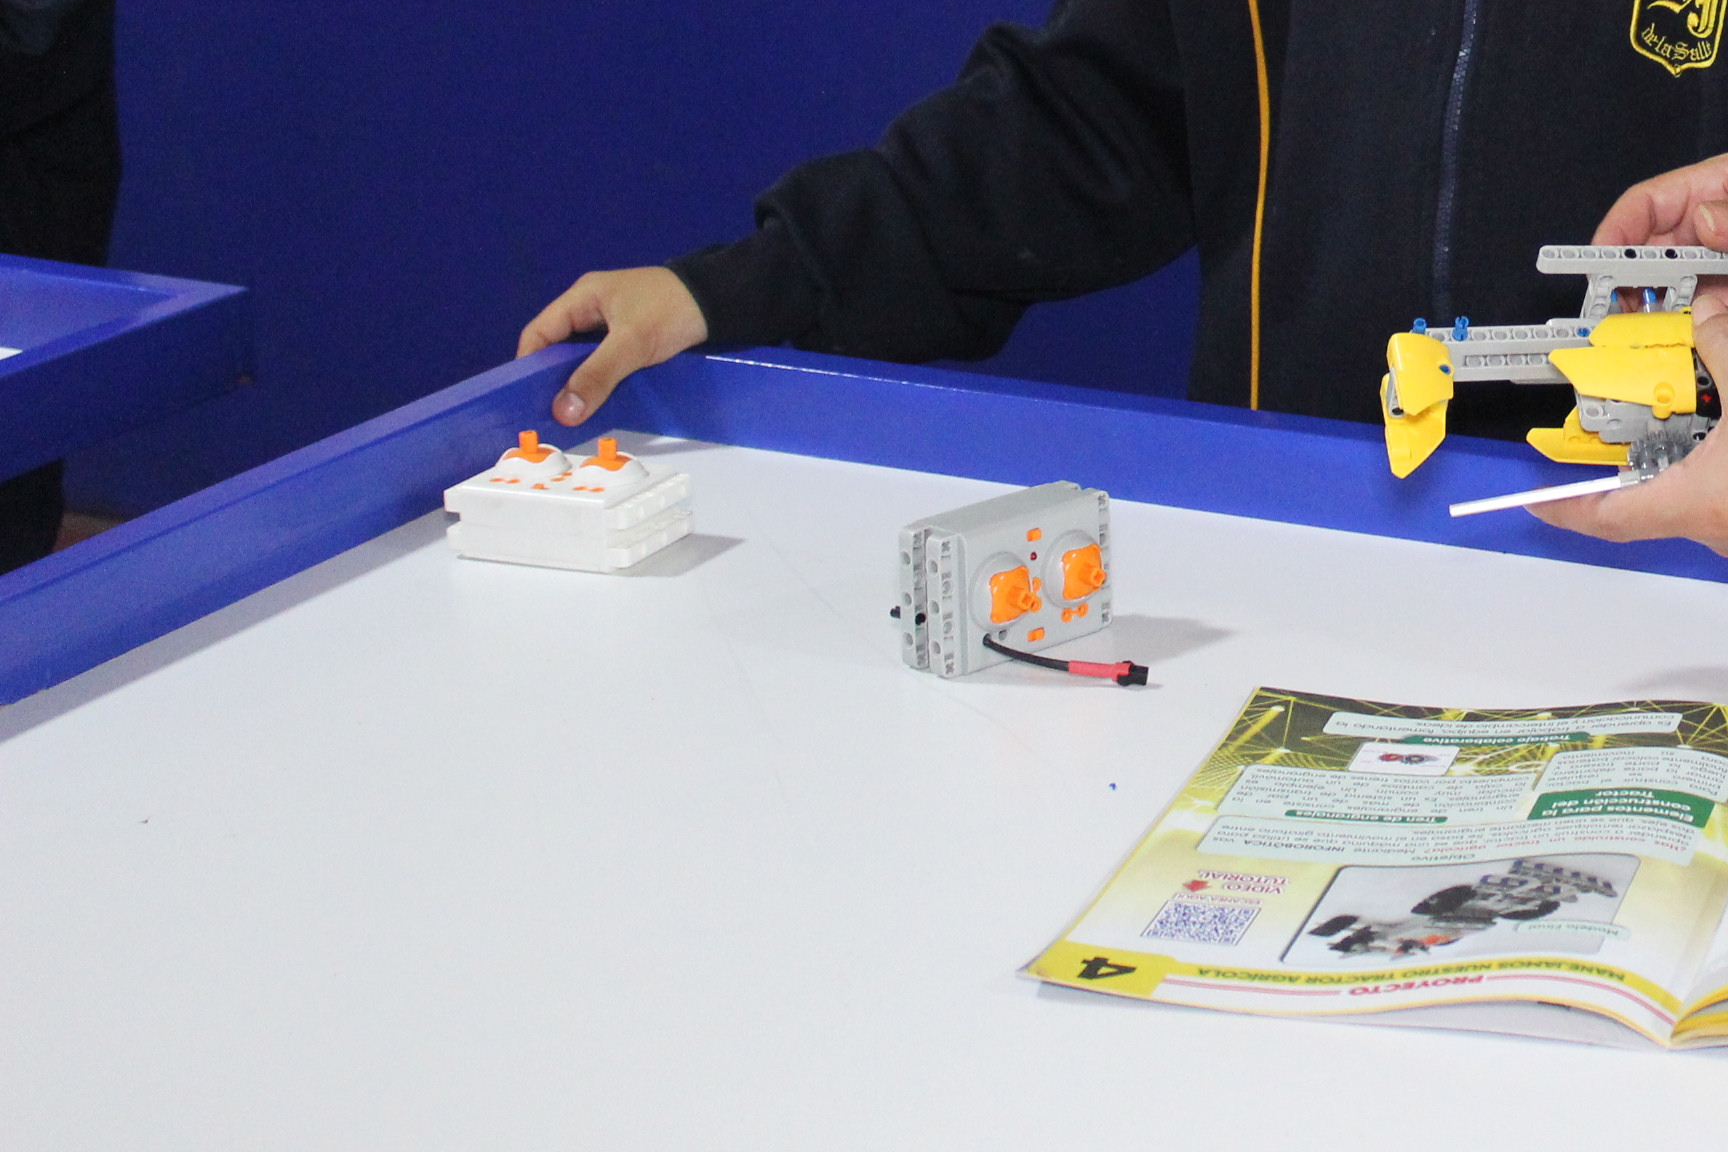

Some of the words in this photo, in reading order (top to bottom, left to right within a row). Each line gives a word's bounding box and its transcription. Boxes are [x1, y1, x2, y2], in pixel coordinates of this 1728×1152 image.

[1423, 737, 1514, 747] colaborativo
[1516, 733, 1571, 745] Trabajo
[1595, 790, 1654, 799] Tractor
[1552, 800, 1579, 809] del
[1541, 809, 1557, 817] la
[1562, 805, 1603, 815] para
[1606, 805, 1694, 822] Elementos
[1296, 810, 1379, 822] engranajes
[1383, 815, 1402, 823] de
[1405, 816, 1435, 824] Tren
[1353, 847, 1416, 855] Mediante
[1412, 853, 1476, 862] Objetivo
[1203, 872, 1287, 886] TUTORIAL
[1226, 884, 1281, 894] VIDEO
[1527, 924, 1559, 933] Final
[1564, 924, 1619, 937] Modelo
[1077, 956, 1136, 980] 4
[1401, 963, 1493, 979] NUESTRO
[1498, 961, 1625, 982] MANEJAMOS
[1305, 972, 1395, 985] TRACTOR
[1349, 975, 1484, 996] PROYECTO
